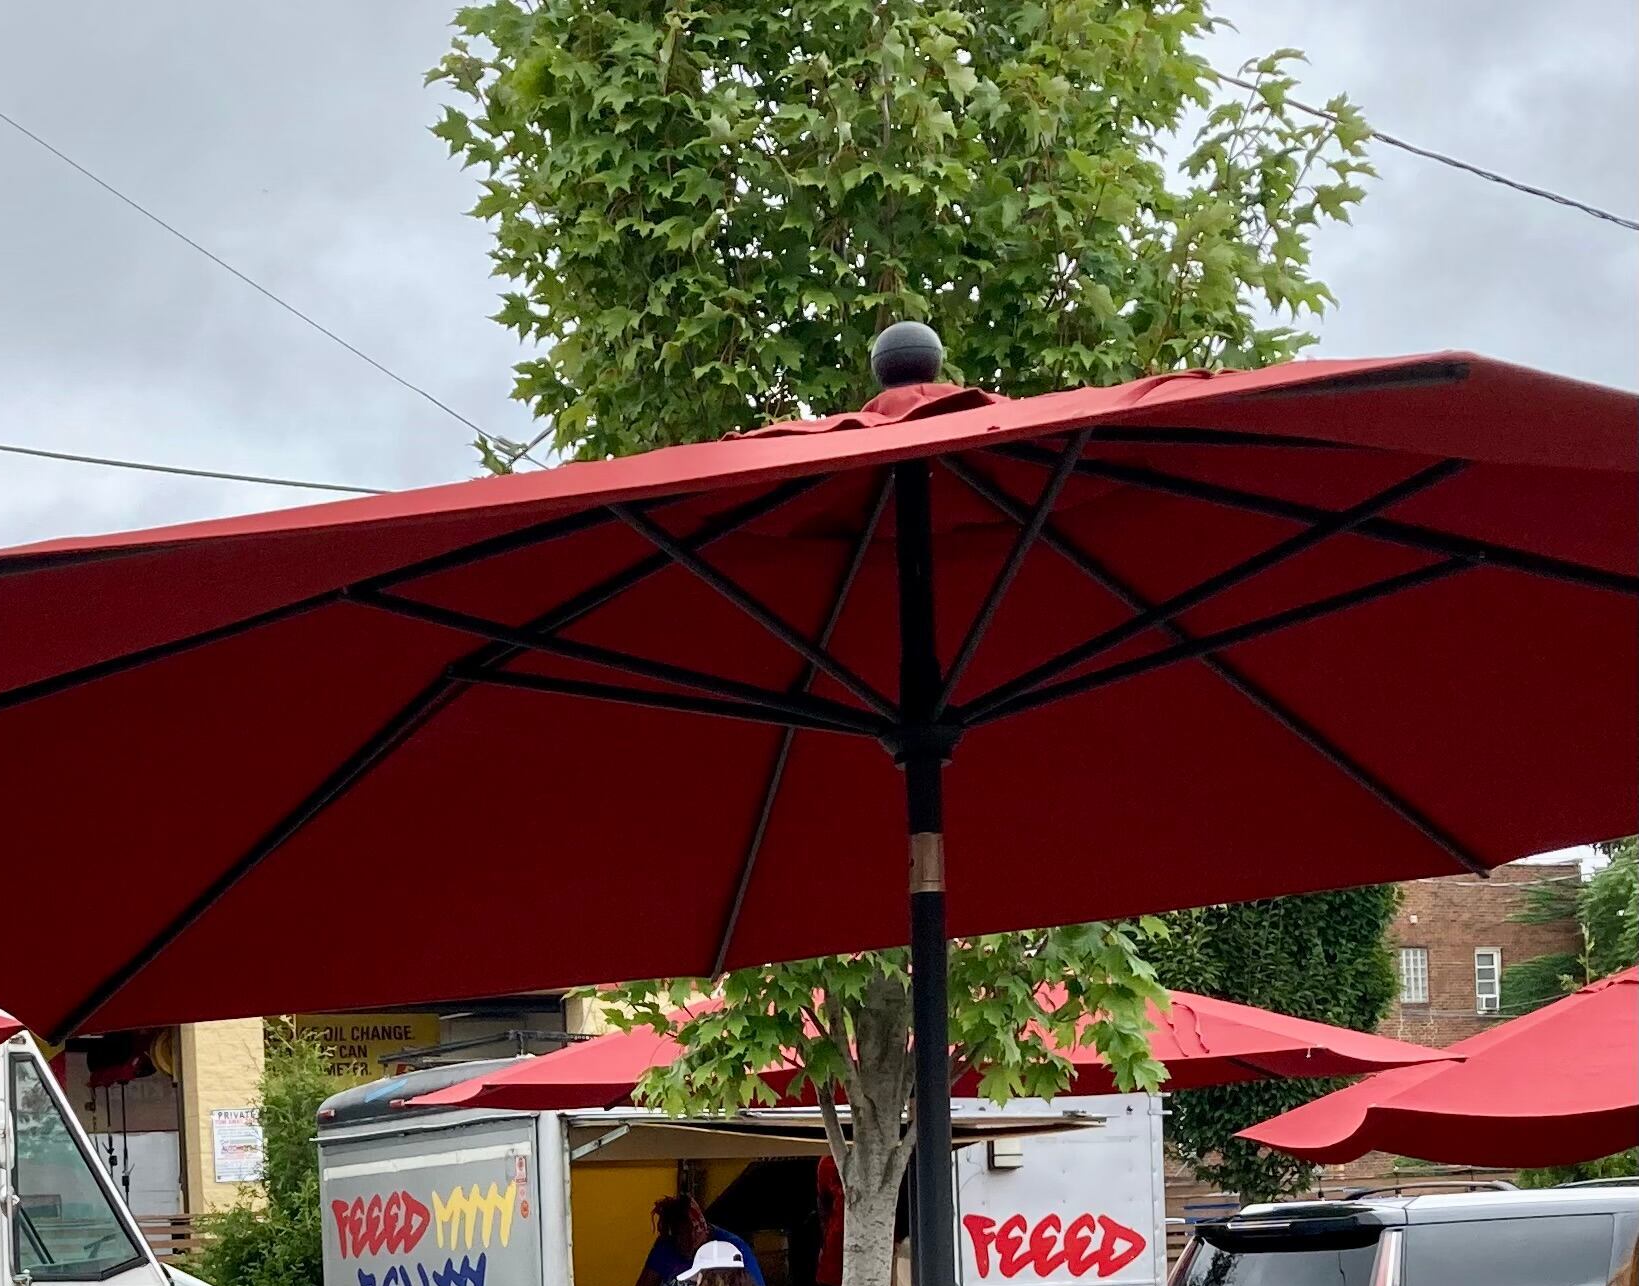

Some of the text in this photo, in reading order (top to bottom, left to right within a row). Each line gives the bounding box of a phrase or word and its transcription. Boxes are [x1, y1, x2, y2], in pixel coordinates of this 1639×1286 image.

[324, 1026, 345, 1041] OIL
[339, 1045, 368, 1058] CAN
[217, 1111, 256, 1119] PRIVATE
[963, 1212, 1146, 1278] FEEED
